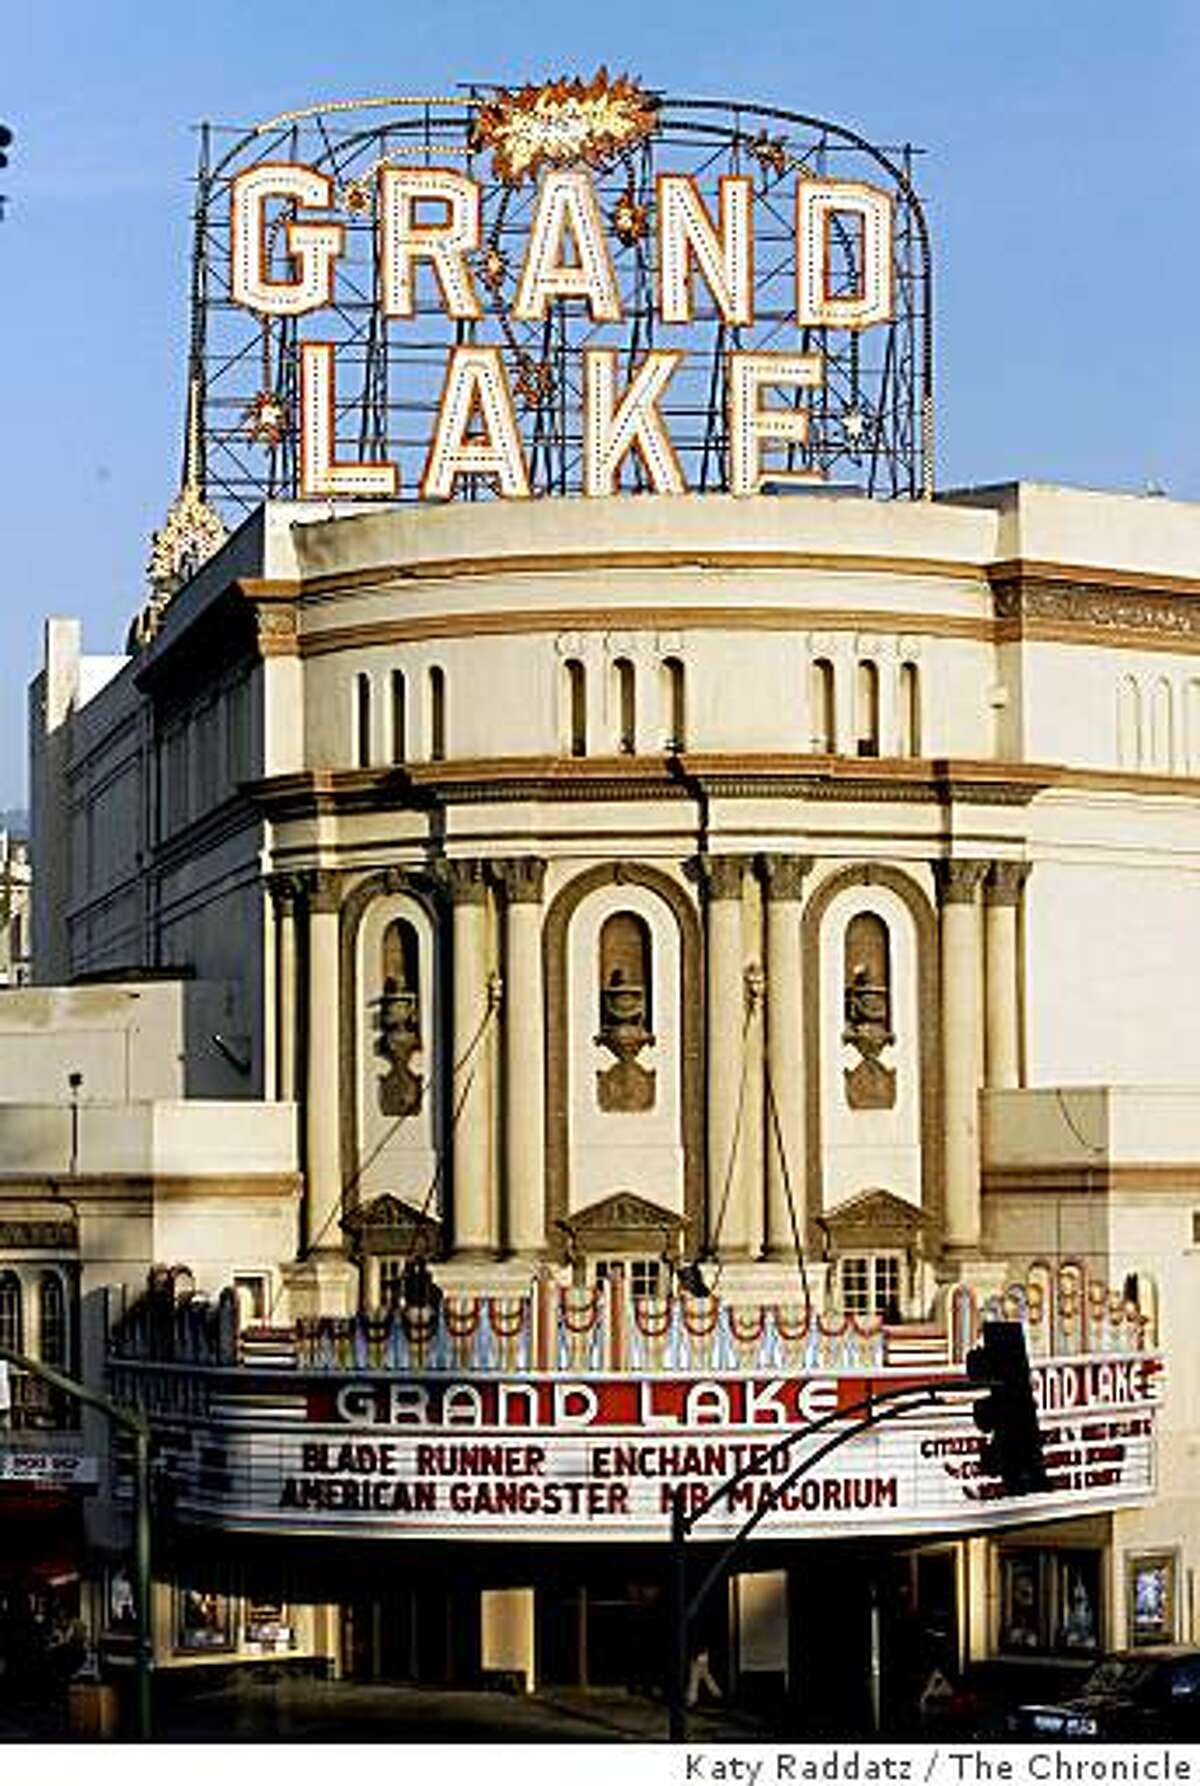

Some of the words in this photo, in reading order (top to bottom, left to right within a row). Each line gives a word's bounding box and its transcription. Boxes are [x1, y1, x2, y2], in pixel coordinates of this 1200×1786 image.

[229, 161, 897, 329] GRAND
[299, 341, 826, 499] LAKE
[337, 1382, 598, 1427] GRAND
[641, 1382, 839, 1427] LAKE
[1031, 1365, 1078, 1411] AND
[302, 1443, 396, 1475] BLADE
[416, 1444, 546, 1477] RUNNER
[592, 1444, 791, 1478] ENCHANTED
[280, 1478, 437, 1513] AMERICAN
[450, 1482, 630, 1515] GANGSTER
[727, 1477, 899, 1514] MAGORIUM
